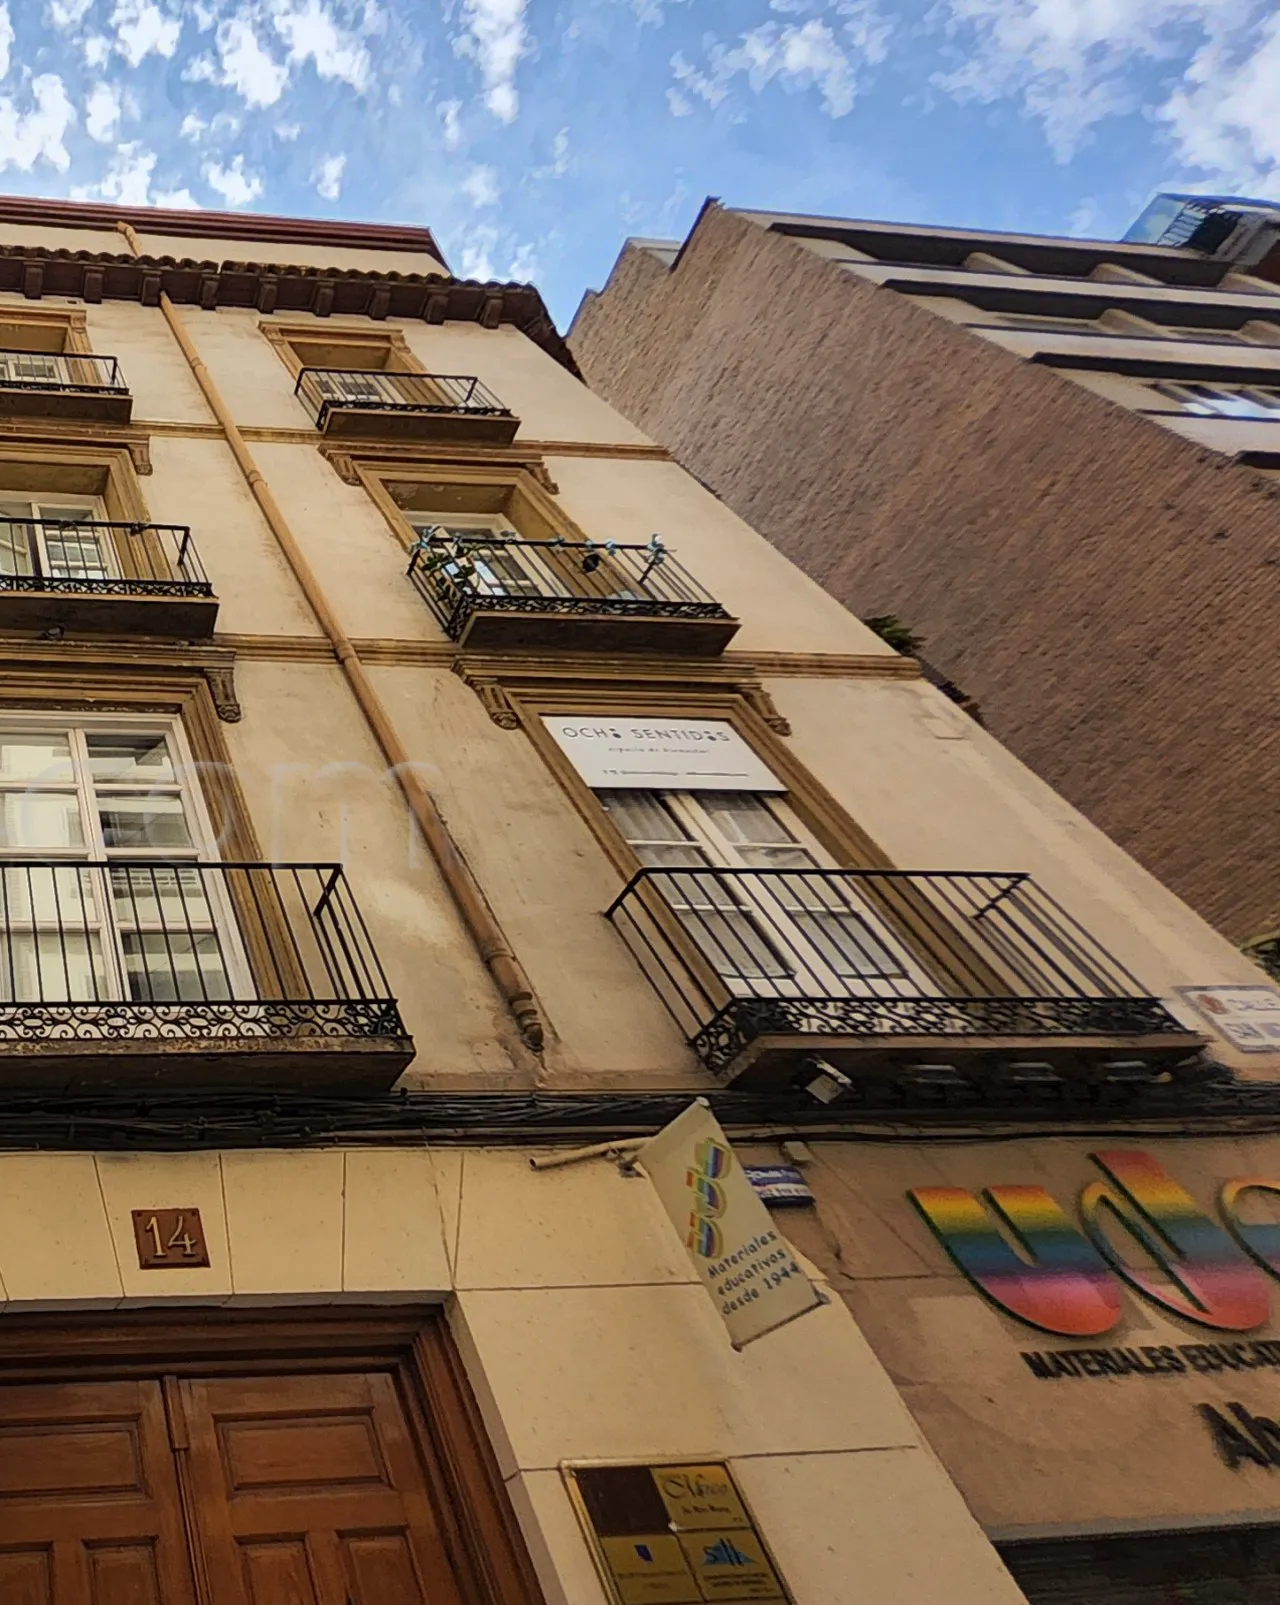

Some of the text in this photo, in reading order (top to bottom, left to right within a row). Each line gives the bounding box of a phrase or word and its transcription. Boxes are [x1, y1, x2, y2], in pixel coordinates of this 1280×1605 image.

[145, 1215, 197, 1258] 14
[706, 1230, 778, 1280] Materiales
[717, 1248, 787, 1296] educativos
[722, 1261, 801, 1316] desde 1944
[1019, 1345, 1187, 1379] MATERIALES
